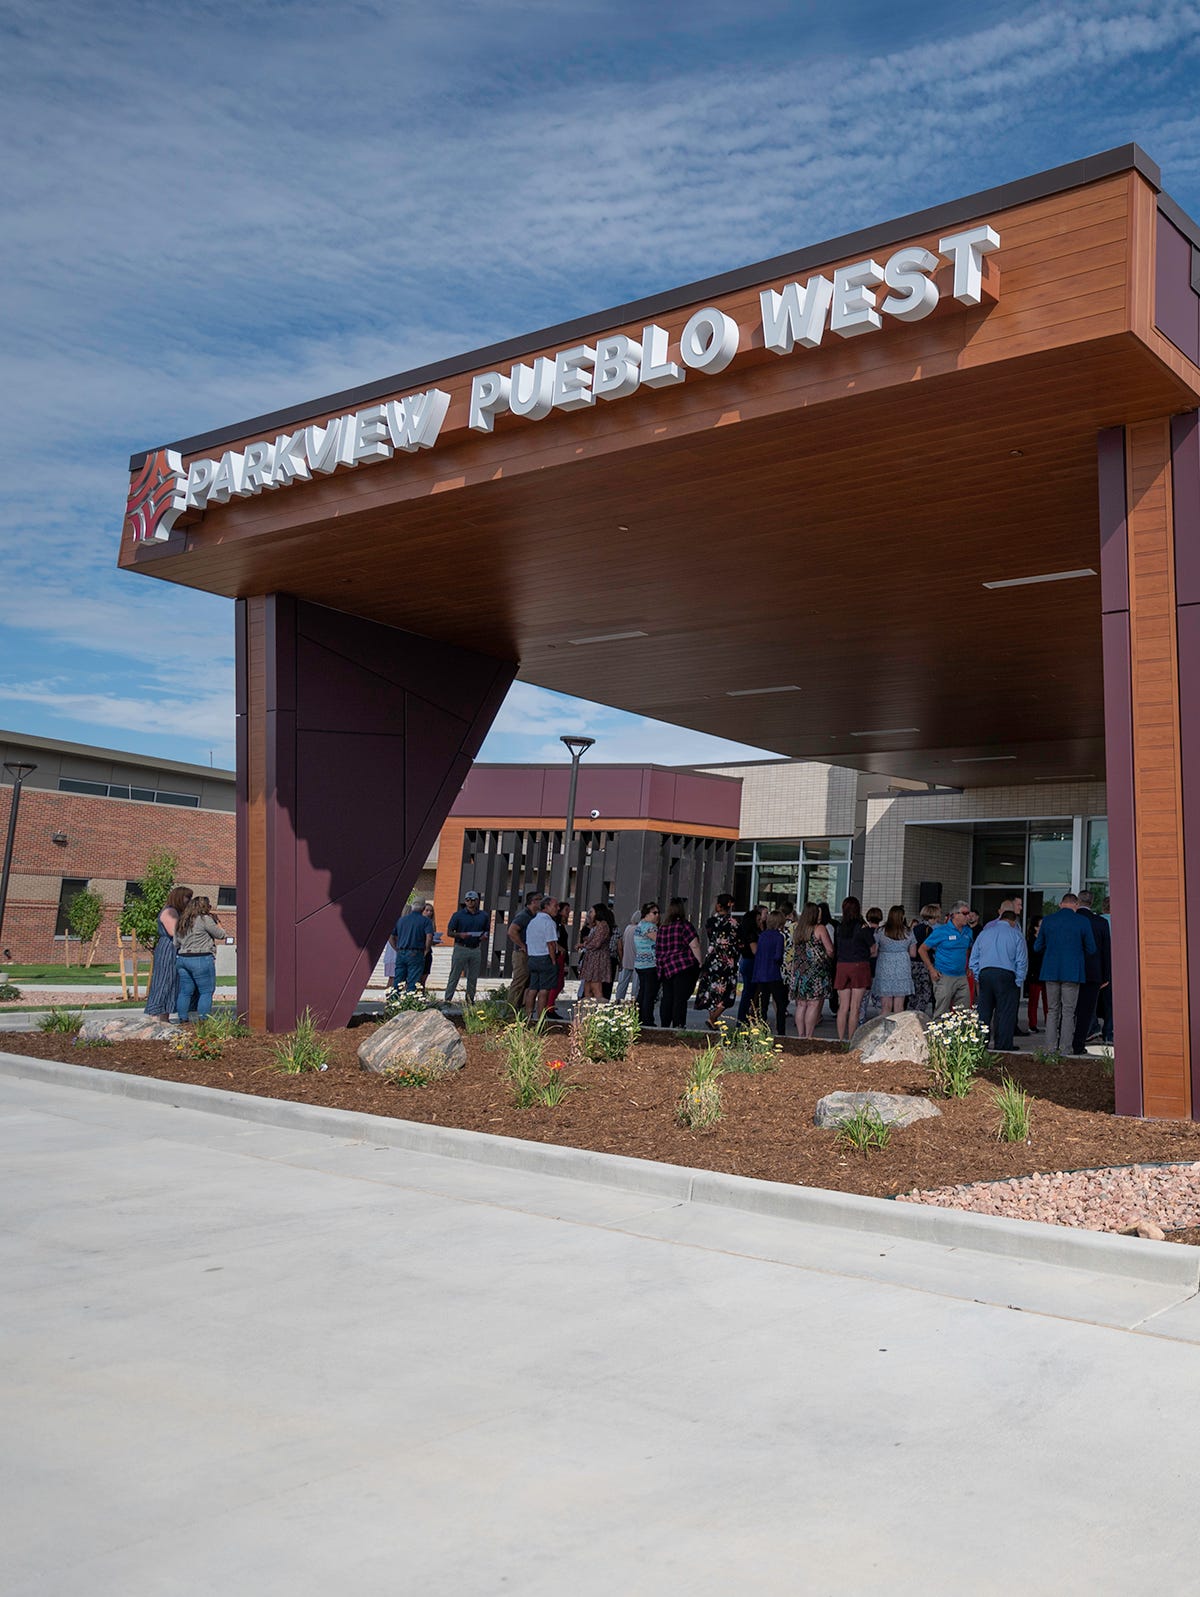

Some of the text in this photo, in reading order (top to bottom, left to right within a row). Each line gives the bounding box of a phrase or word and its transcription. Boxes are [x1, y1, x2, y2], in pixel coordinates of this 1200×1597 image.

[185, 224, 1000, 509] PARKVIEW PUEBLO WEST
